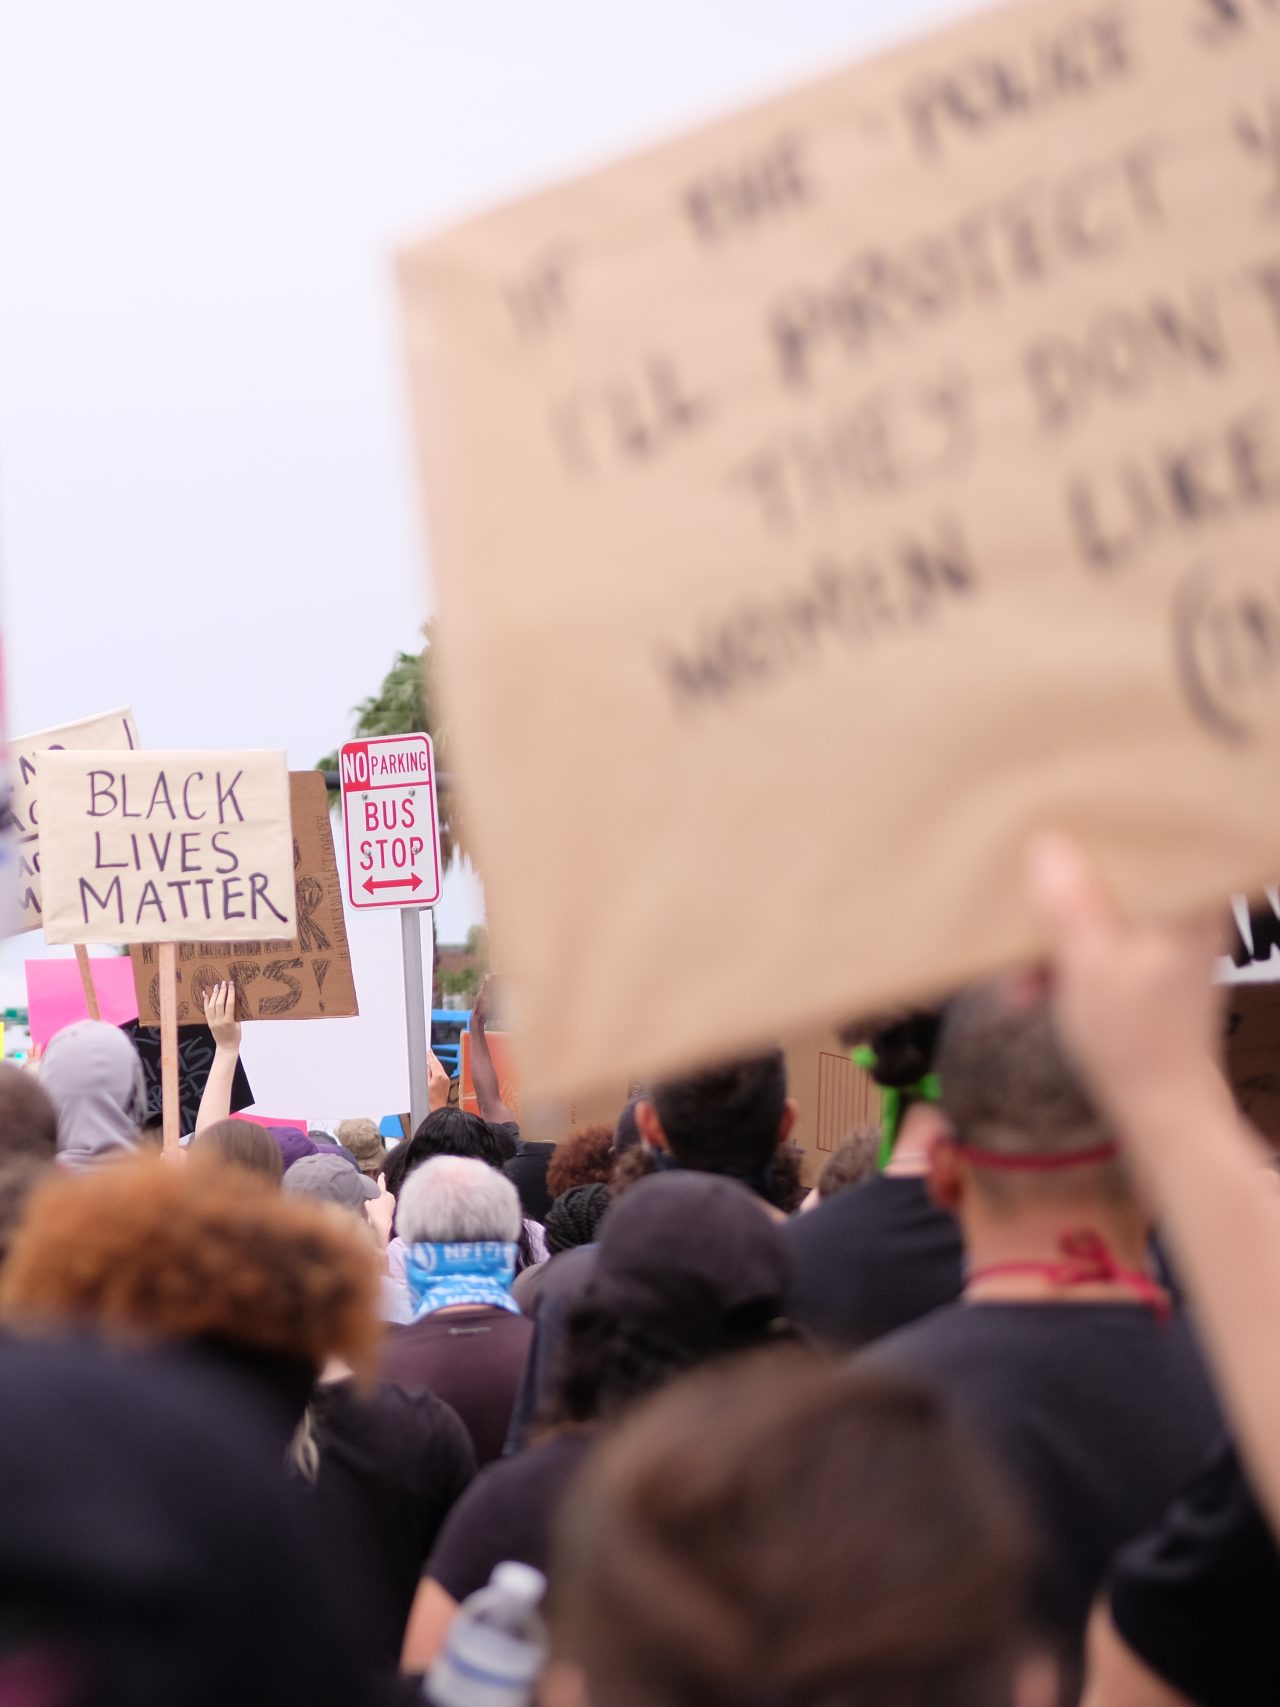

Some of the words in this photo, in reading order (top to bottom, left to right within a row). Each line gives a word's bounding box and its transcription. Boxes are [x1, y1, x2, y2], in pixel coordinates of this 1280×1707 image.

[767, 138, 1170, 390] PROTECT
[730, 368, 978, 531] THEY
[1066, 410, 1280, 574] LIKE
[342, 752, 368, 784] NO
[371, 751, 426, 776] PARKING
[86, 770, 245, 824] BLACK
[364, 798, 415, 831] BUS
[95, 831, 239, 874] LIVES
[360, 836, 424, 870] STOP
[79, 872, 288, 924] MATTER
